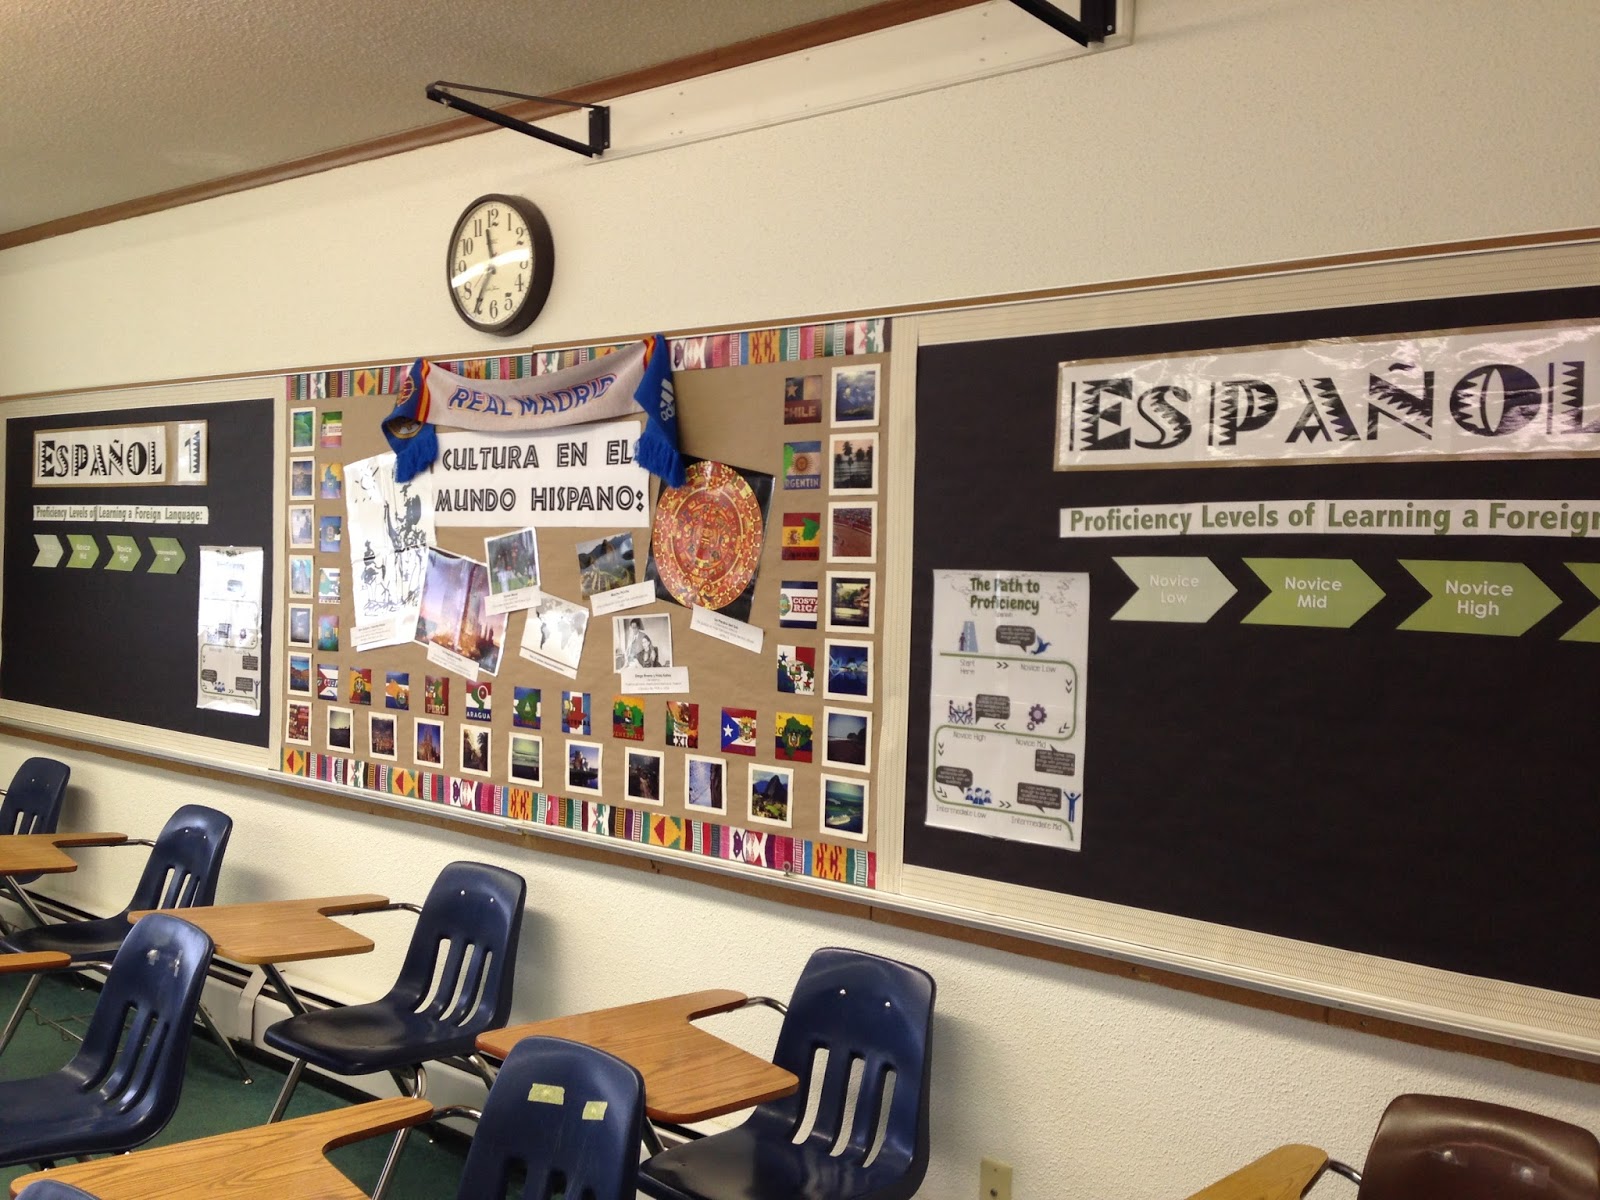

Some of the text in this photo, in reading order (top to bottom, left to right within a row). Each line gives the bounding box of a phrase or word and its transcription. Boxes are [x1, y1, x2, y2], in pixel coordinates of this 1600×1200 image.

[487, 208, 499, 228] 12
[507, 212, 512, 232] 1
[474, 219, 482, 238] 11
[516, 227, 524, 246] 2
[462, 238, 474, 256] 10
[464, 282, 472, 300] 8
[514, 273, 524, 292] 4
[489, 300, 498, 319] 6
[504, 292, 513, 310] 5
[448, 372, 618, 417] REAL MADRID
[1069, 360, 1600, 452] ESPAÑOL
[38, 430, 201, 478] ESPAÑOL 1
[442, 439, 634, 471] CULTURA EN EL
[434, 485, 645, 513] MUNDO HISPANO:
[36, 506, 68, 521] Proficiency
[69, 506, 88, 518] Levels
[98, 506, 127, 522] Learning
[128, 510, 132, 518] a
[135, 507, 162, 523] Foreign
[164, 508, 203, 524] Language:
[1071, 507, 1192, 535] Proficiency
[1202, 504, 1279, 528] Levels
[1288, 502, 1316, 527] of
[1328, 502, 1451, 535] Learning
[1462, 509, 1479, 528] a
[970, 578, 1040, 593] The Path to
[1150, 574, 1200, 588] Novice
[1284, 576, 1343, 592] Novice
[1445, 580, 1514, 597] Novice
[970, 594, 1040, 616] Proficiency
[1160, 591, 1188, 604] Low
[1297, 594, 1328, 610] Mid
[1457, 600, 1500, 619] High
[1020, 663, 1057, 673] Novice Low
[427, 702, 447, 715] PERÚ
